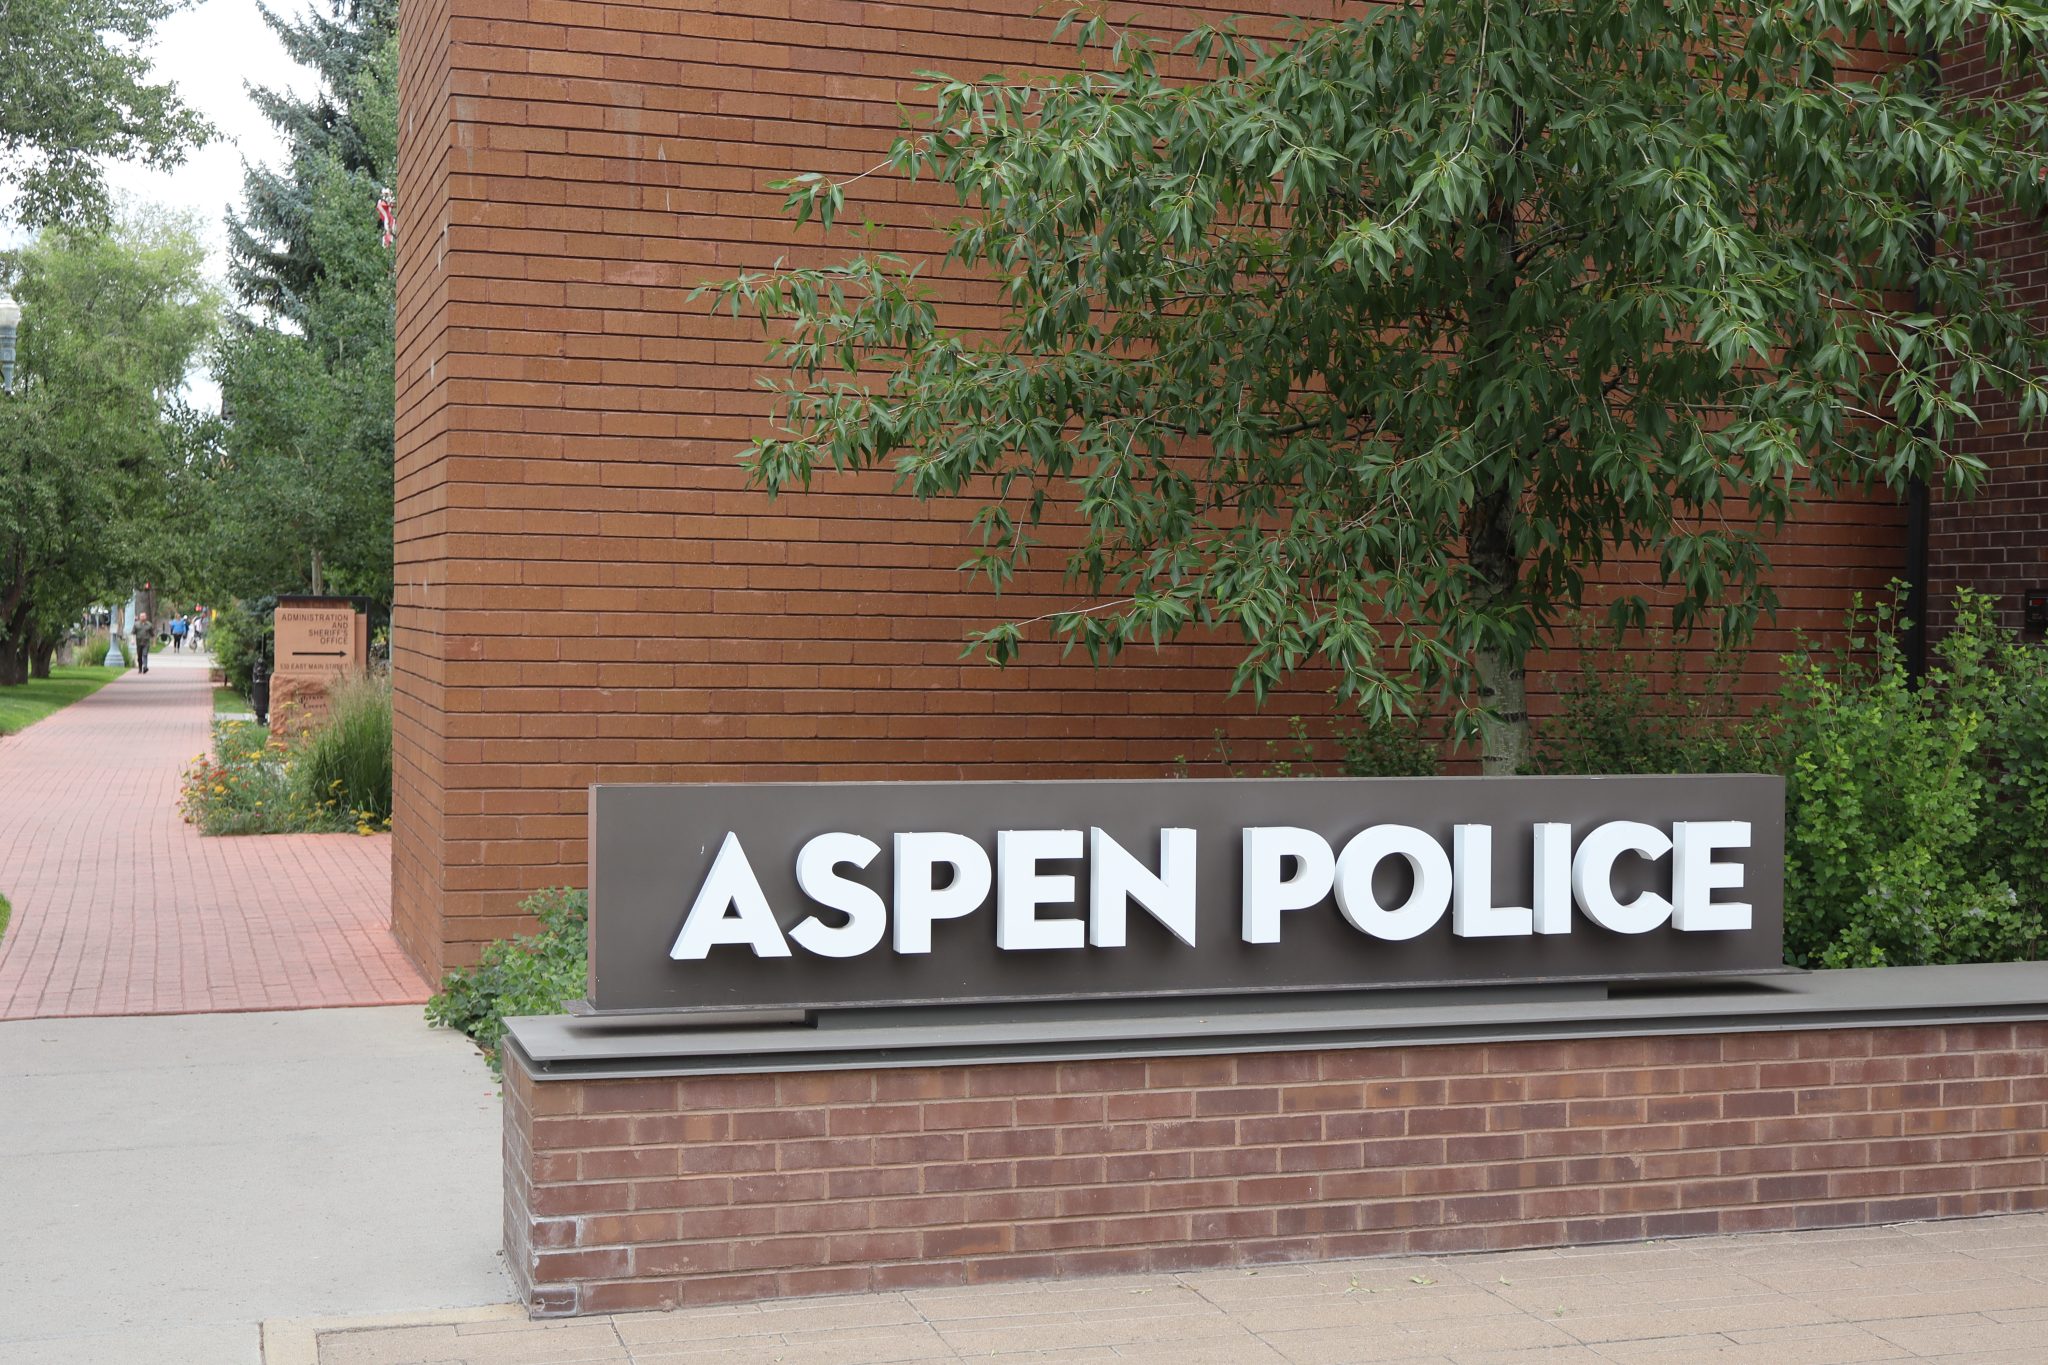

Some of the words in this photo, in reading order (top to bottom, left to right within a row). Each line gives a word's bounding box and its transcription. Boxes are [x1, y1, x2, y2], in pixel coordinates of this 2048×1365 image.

[282, 613, 349, 621] ADMINISTRATION
[308, 629, 349, 637] SHERIFF'S
[320, 637, 348, 645] OFFICE
[669, 826, 1198, 961] ASPEN
[1242, 820, 1752, 944] POLICE
